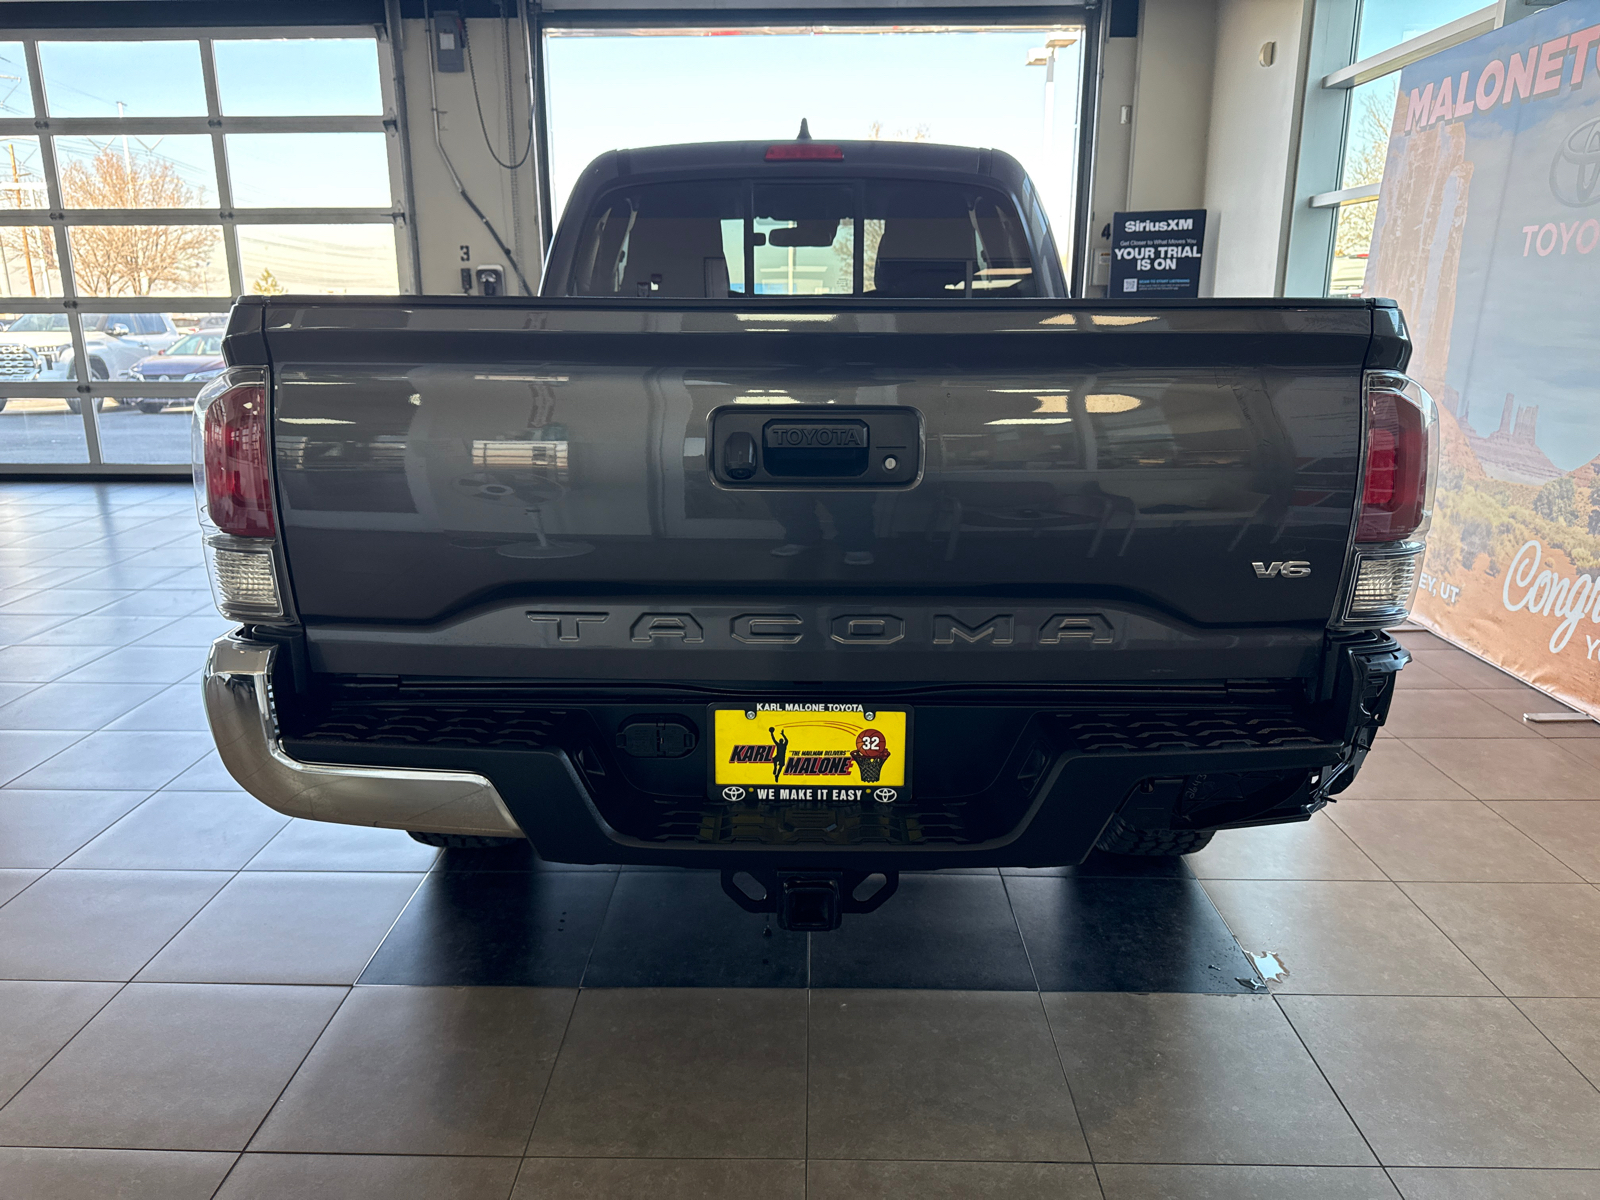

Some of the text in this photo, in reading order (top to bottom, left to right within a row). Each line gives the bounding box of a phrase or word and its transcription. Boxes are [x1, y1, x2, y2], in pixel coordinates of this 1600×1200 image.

[1404, 24, 1600, 136] MALONET
[1101, 222, 1111, 240] 4
[1124, 218, 1194, 233] SiriusXM
[1130, 239, 1146, 247] Closer
[460, 245, 470, 262] 3
[1114, 246, 1201, 260] YOUR TRIAL
[1137, 259, 1177, 271] IS ON
[773, 428, 861, 446] TOYOTA
[1251, 560, 1311, 578] V6
[1440, 581, 1460, 603] UT
[525, 611, 1114, 645] TACOMA
[756, 703, 864, 712] KARL MALONE TOYOTA
[862, 736, 880, 751] 32
[729, 745, 776, 764] KARL
[783, 757, 853, 776] MALONE
[757, 789, 863, 801] WE MAKE IT EASY
